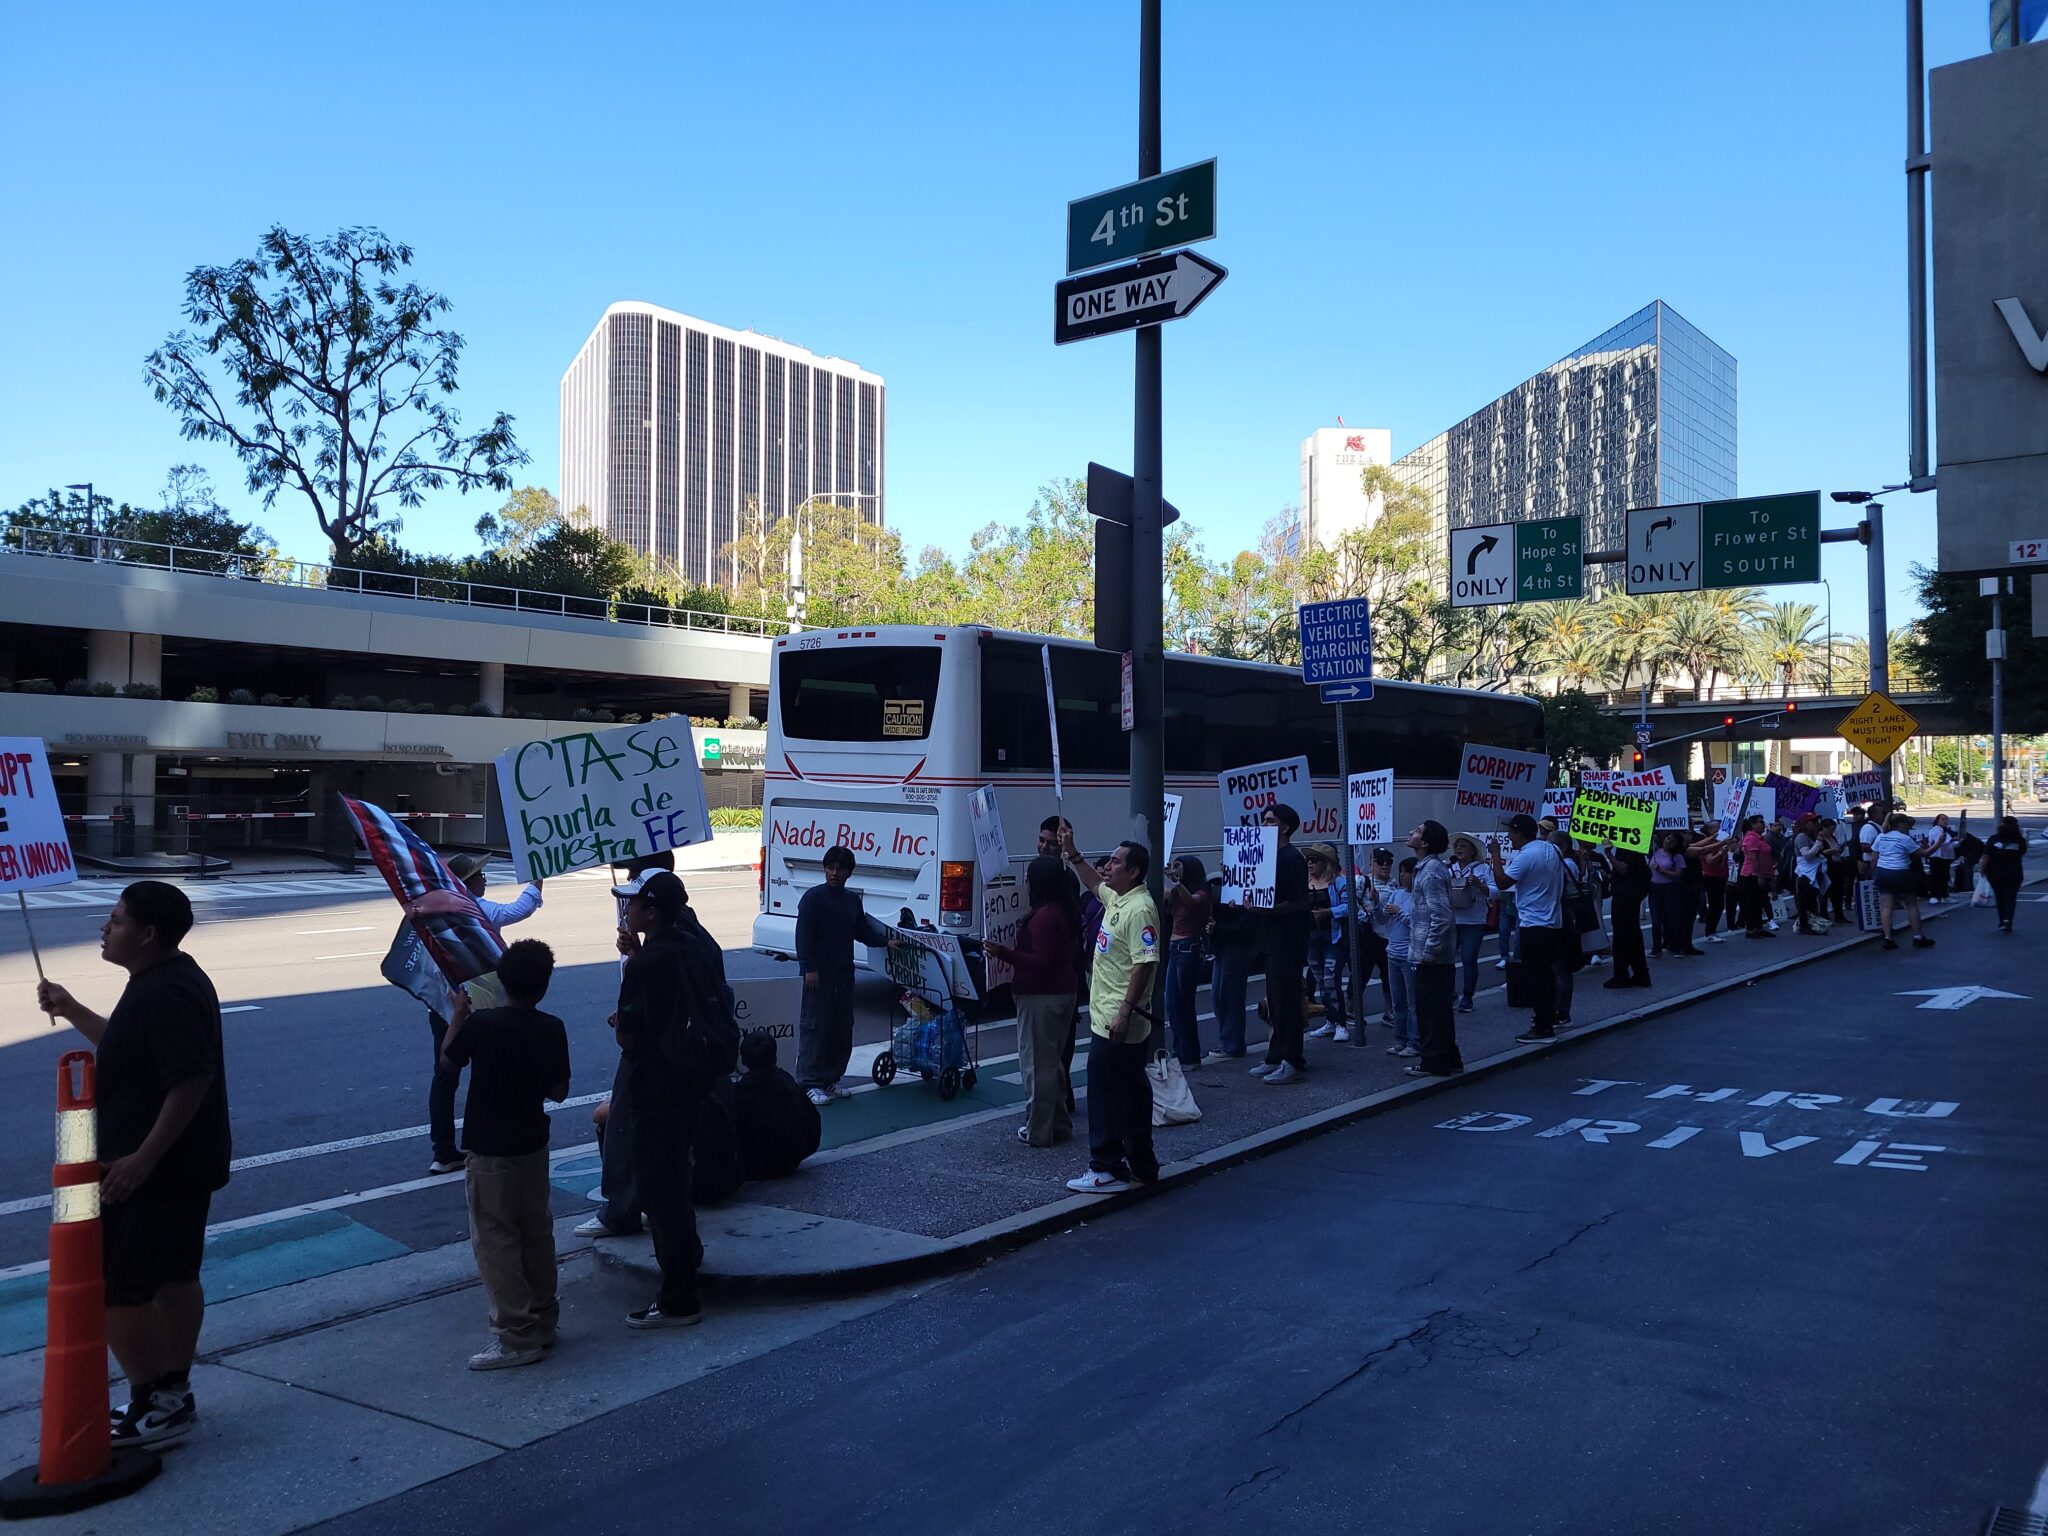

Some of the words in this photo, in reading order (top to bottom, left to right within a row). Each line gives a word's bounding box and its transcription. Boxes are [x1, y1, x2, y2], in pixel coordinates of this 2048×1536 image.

[1090, 203, 1144, 246] 4th
[1155, 192, 1189, 227] St
[1072, 289, 1117, 320] ONE
[1125, 275, 1173, 308] WAY
[1749, 510, 1770, 525] To
[1541, 527, 1557, 540] To
[1714, 530, 1779, 547] Flower
[1787, 525, 1808, 540] St
[1522, 546, 1557, 561] Hope
[1562, 542, 1578, 556] St
[1544, 563, 1553, 573] &
[1631, 561, 1696, 584] ONLY
[1723, 555, 1796, 574] SOUTH
[1456, 576, 1509, 598] ONLY
[1522, 576, 1551, 591] 4th
[1556, 575, 1574, 588] St
[1303, 603, 1365, 625] ELECTRIC
[1308, 622, 1363, 642] VEHICLE
[800, 637, 822, 650] 5726
[1304, 640, 1370, 661] CHARGING
[1311, 658, 1364, 677] STATION
[1872, 703, 1881, 714] 2
[885, 713, 922, 725] CAUTION
[1850, 716, 1874, 725] RIGHT
[1878, 714, 1907, 724] LANES
[884, 726, 900, 735] WIDE
[901, 726, 922, 735] TURNS
[1852, 726, 1876, 735] MUST
[1880, 725, 1905, 734] TURN
[225, 731, 268, 750] EXIT
[273, 733, 322, 751] ONLY
[705, 742, 766, 758] enterpri
[1866, 737, 1892, 745] RIGHT
[515, 733, 626, 801] CTA
[1467, 754, 1536, 783] CORRUPT
[1583, 771, 1610, 781] SHAME
[1612, 772, 1625, 780] ON
[1227, 765, 1299, 795] PROTECT
[1350, 776, 1388, 799] PROTECT
[1843, 775, 1857, 789] CTA
[1857, 771, 1881, 786] MOCKS
[1243, 792, 1277, 810] OUR
[1457, 790, 1498, 809] TEACHER
[1500, 795, 1535, 814] UNION
[1578, 788, 1653, 813] PEDOPHILES
[1859, 788, 1882, 802] FAITH
[520, 794, 616, 846] burla
[631, 783, 674, 818] de
[1359, 803, 1376, 821] OUR
[1576, 804, 1616, 821] KEEP
[642, 810, 692, 852] FE
[771, 819, 825, 848] Nada
[835, 823, 881, 857] Bus,
[892, 827, 936, 856] Inc.
[1224, 827, 1261, 847] TEACHER
[1356, 822, 1380, 841] KIDS!
[1571, 818, 1641, 846] SECRETS
[20, 842, 71, 880] UNION
[1238, 845, 1264, 866] UNION
[1222, 864, 1257, 888] BULLIES
[1243, 886, 1274, 907] FAITHS
[1570, 1077, 1961, 1118] THRU
[1432, 1110, 1948, 1172] DRIVE
